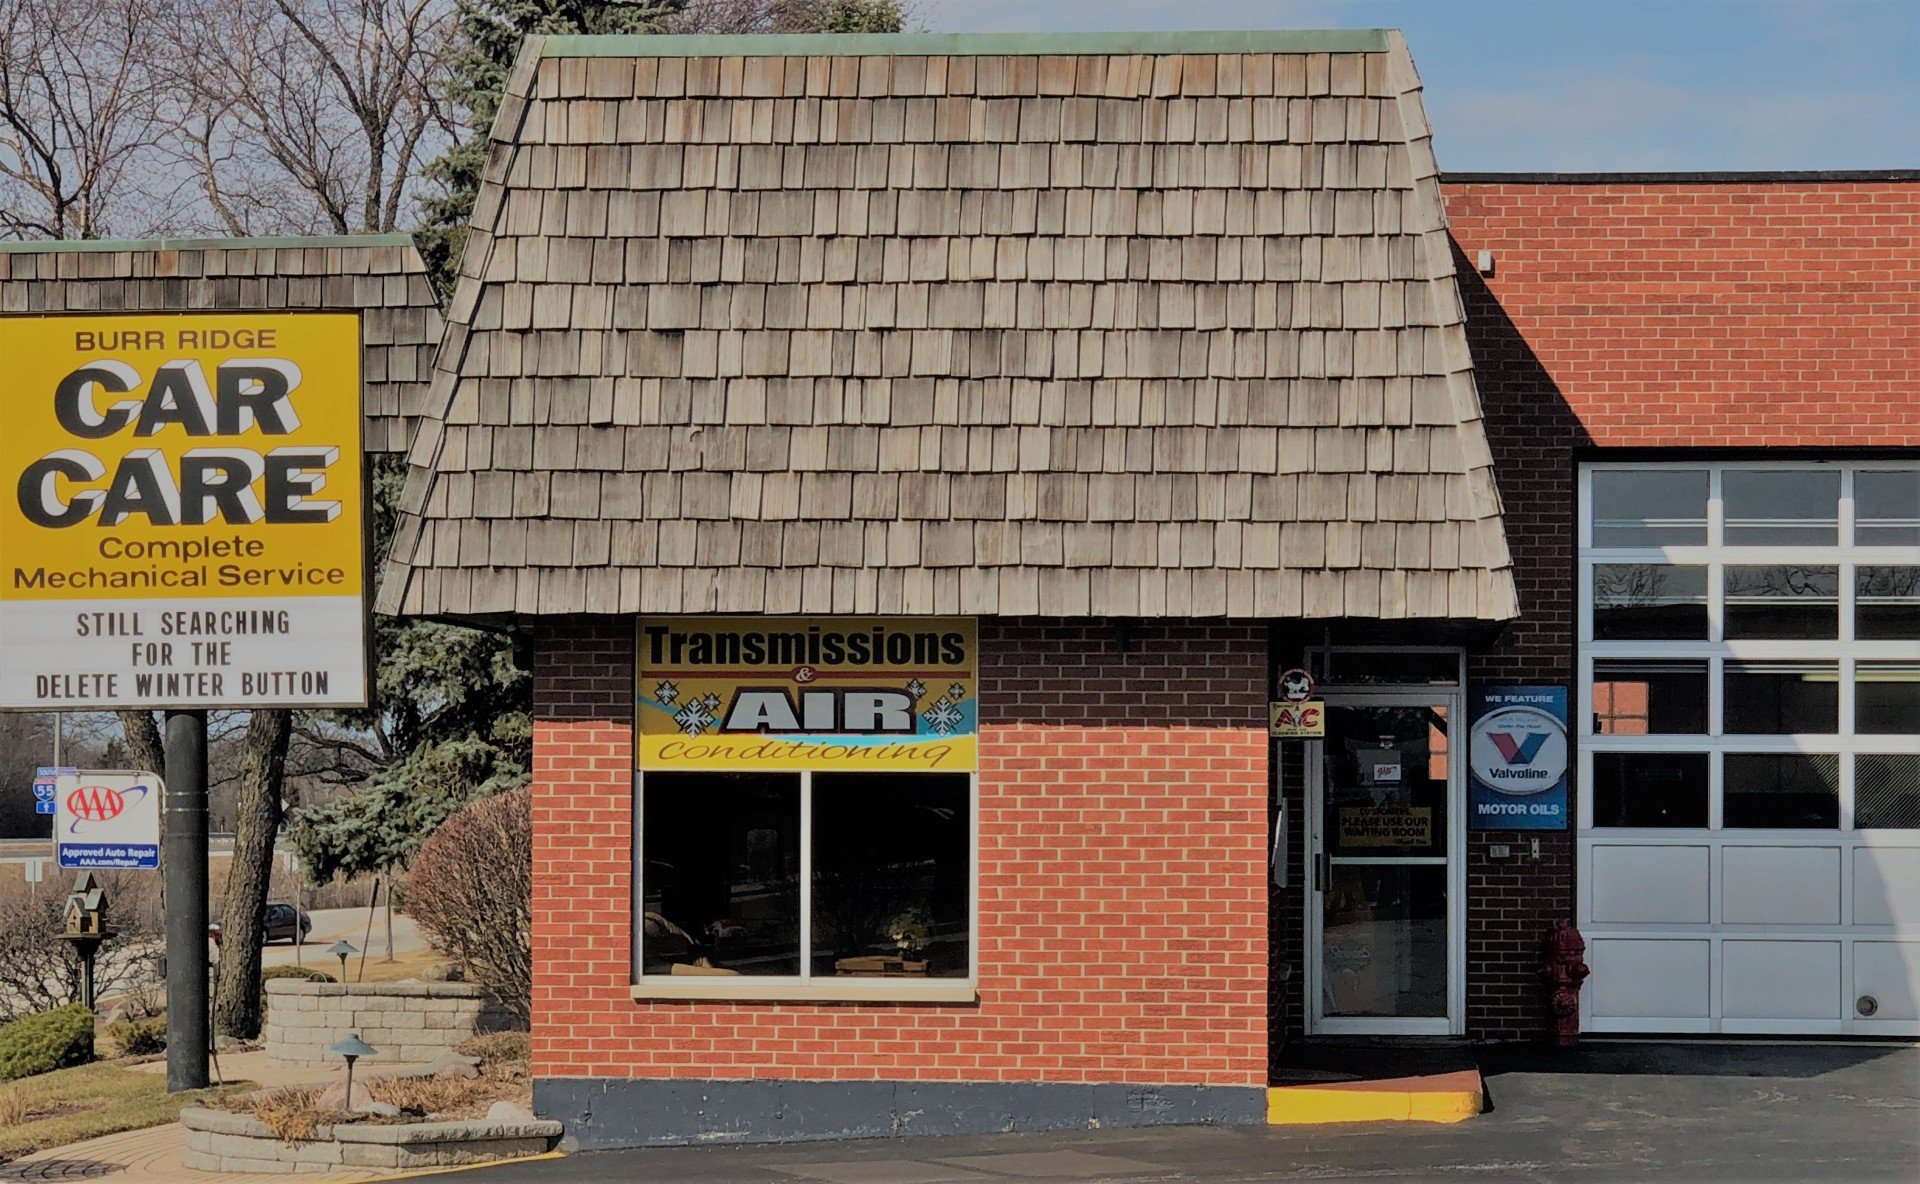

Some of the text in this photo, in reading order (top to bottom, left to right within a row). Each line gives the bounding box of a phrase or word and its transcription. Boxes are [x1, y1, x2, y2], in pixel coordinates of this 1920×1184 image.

[75, 329, 277, 352] BURR RIDGE
[54, 358, 303, 439] CAR
[16, 446, 343, 529] CARE
[99, 536, 265, 563] Complete
[14, 562, 345, 589] Mechanical Service
[77, 610, 290, 637] STILL SEARCHING
[132, 642, 232, 667] FOR THE
[644, 626, 965, 665] Transmissions
[36, 670, 329, 699] DELETE WINTER BUTTON
[795, 667, 813, 682] &
[721, 688, 914, 733] AIR
[1485, 695, 1554, 703] WE FEATURE
[1489, 767, 1549, 779] Valvoline
[37, 785, 54, 797] 55
[70, 786, 121, 821] AAA
[1478, 803, 1560, 815] MOTOR OILS
[1382, 817, 1403, 826] USE
[1404, 817, 1428, 826] OUR
[1392, 827, 1425, 837] ROOM
[62, 847, 156, 859] Approved Auto Repair
[79, 858, 139, 868] AAA.com/Repair
